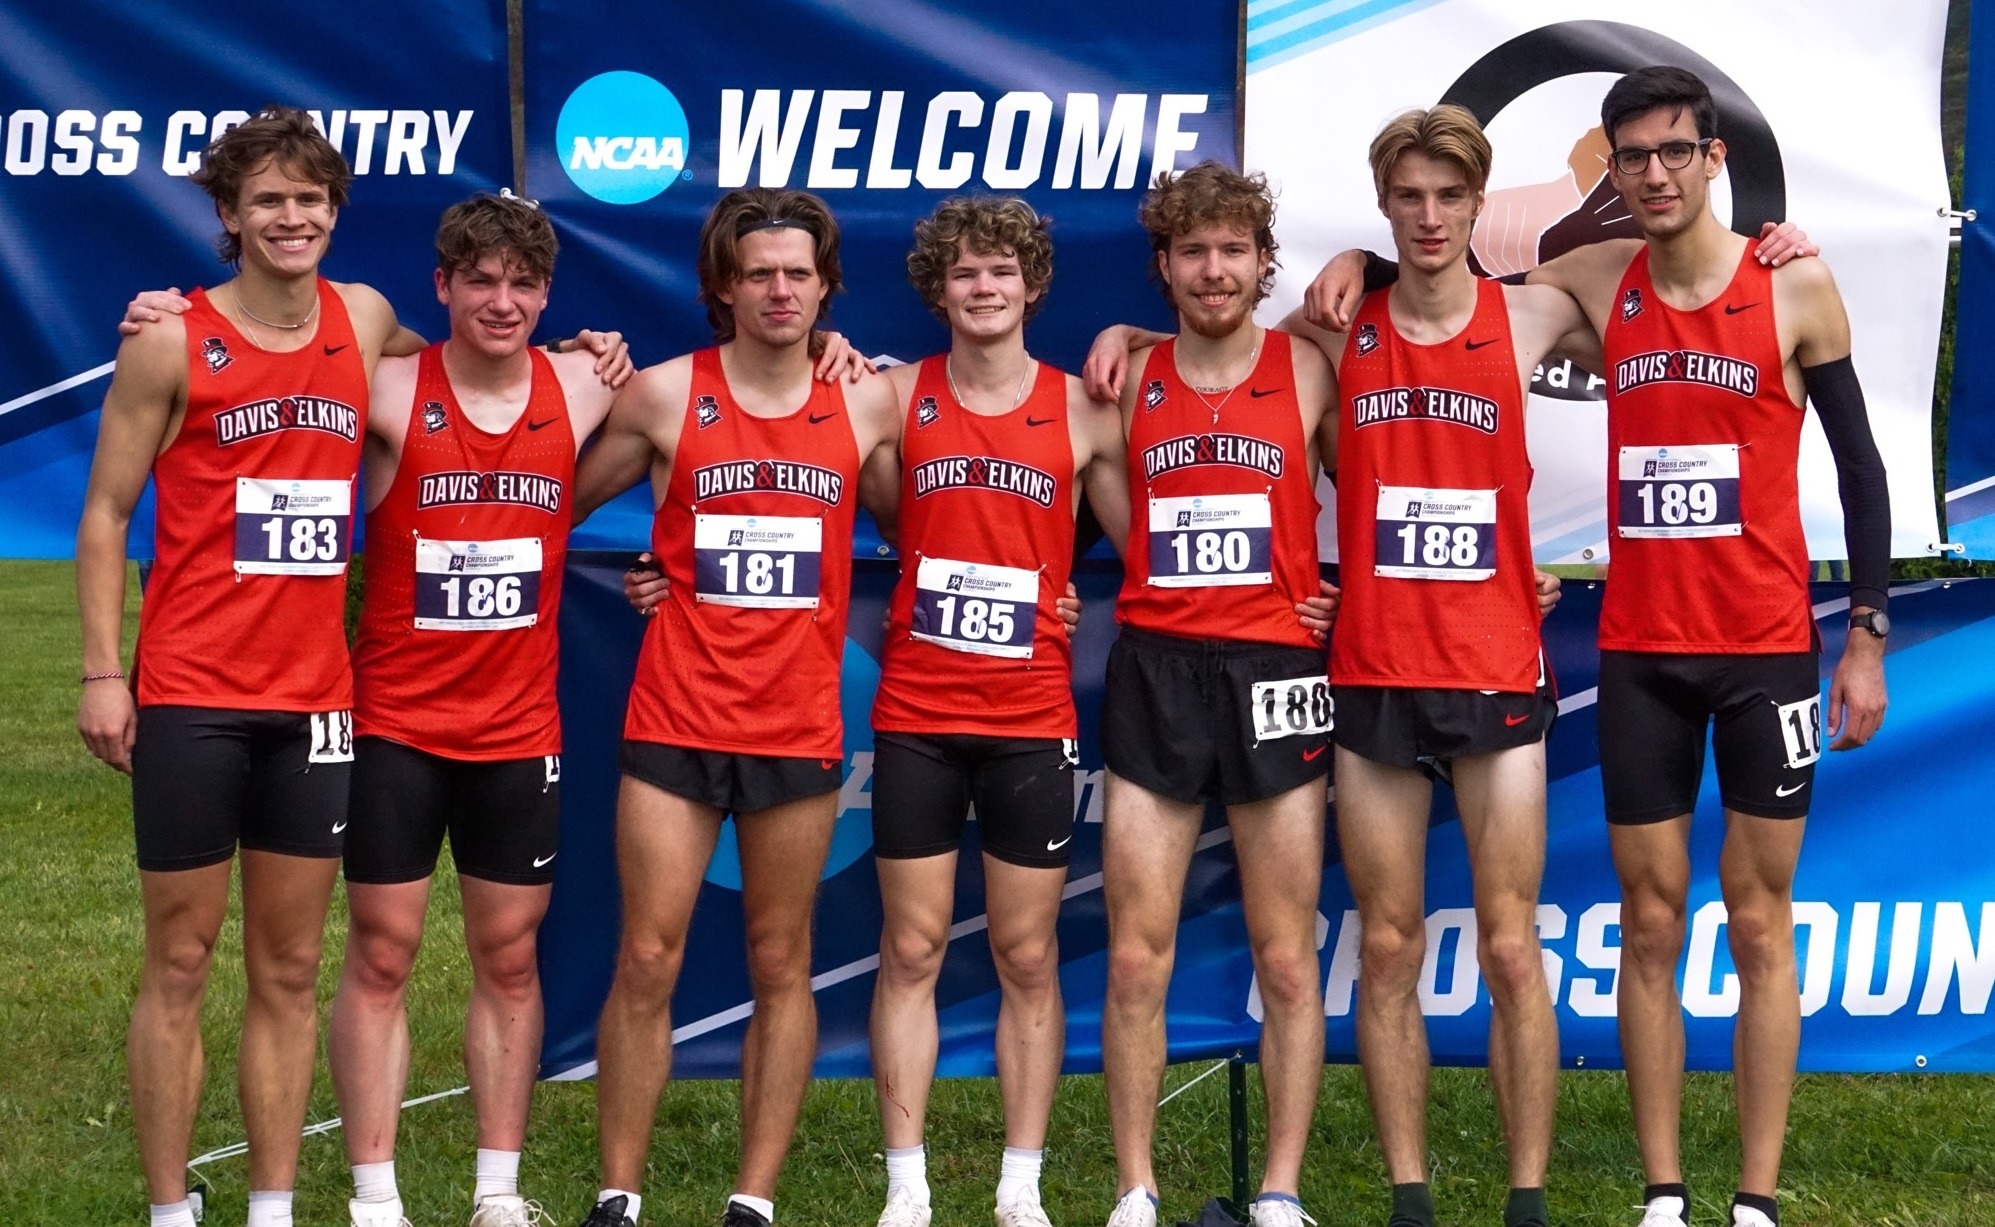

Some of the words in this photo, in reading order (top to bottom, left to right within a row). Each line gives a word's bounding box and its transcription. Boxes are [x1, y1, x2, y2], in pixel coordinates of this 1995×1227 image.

[0, 109, 143, 176] OSS
[162, 109, 475, 177] CNTRY
[570, 136, 684, 170] NCAA
[717, 88, 1209, 190] WELCOME
[1679, 460, 1708, 468] COUNTRY
[1637, 482, 1718, 524] 189
[261, 517, 338, 560] 183
[1171, 531, 1251, 573] 180
[1397, 523, 1479, 567] 188
[719, 552, 795, 595] 181
[964, 577, 984, 586] CROSS
[985, 580, 1013, 589] COUNTRY
[440, 576, 522, 617] 186
[936, 596, 1015, 643] 185
[1261, 682, 1331, 733] 180
[316, 711, 350, 756] 18
[1788, 702, 1821, 760] 18
[1246, 902, 1621, 1023] OSS
[1681, 901, 1995, 1017] COUN
